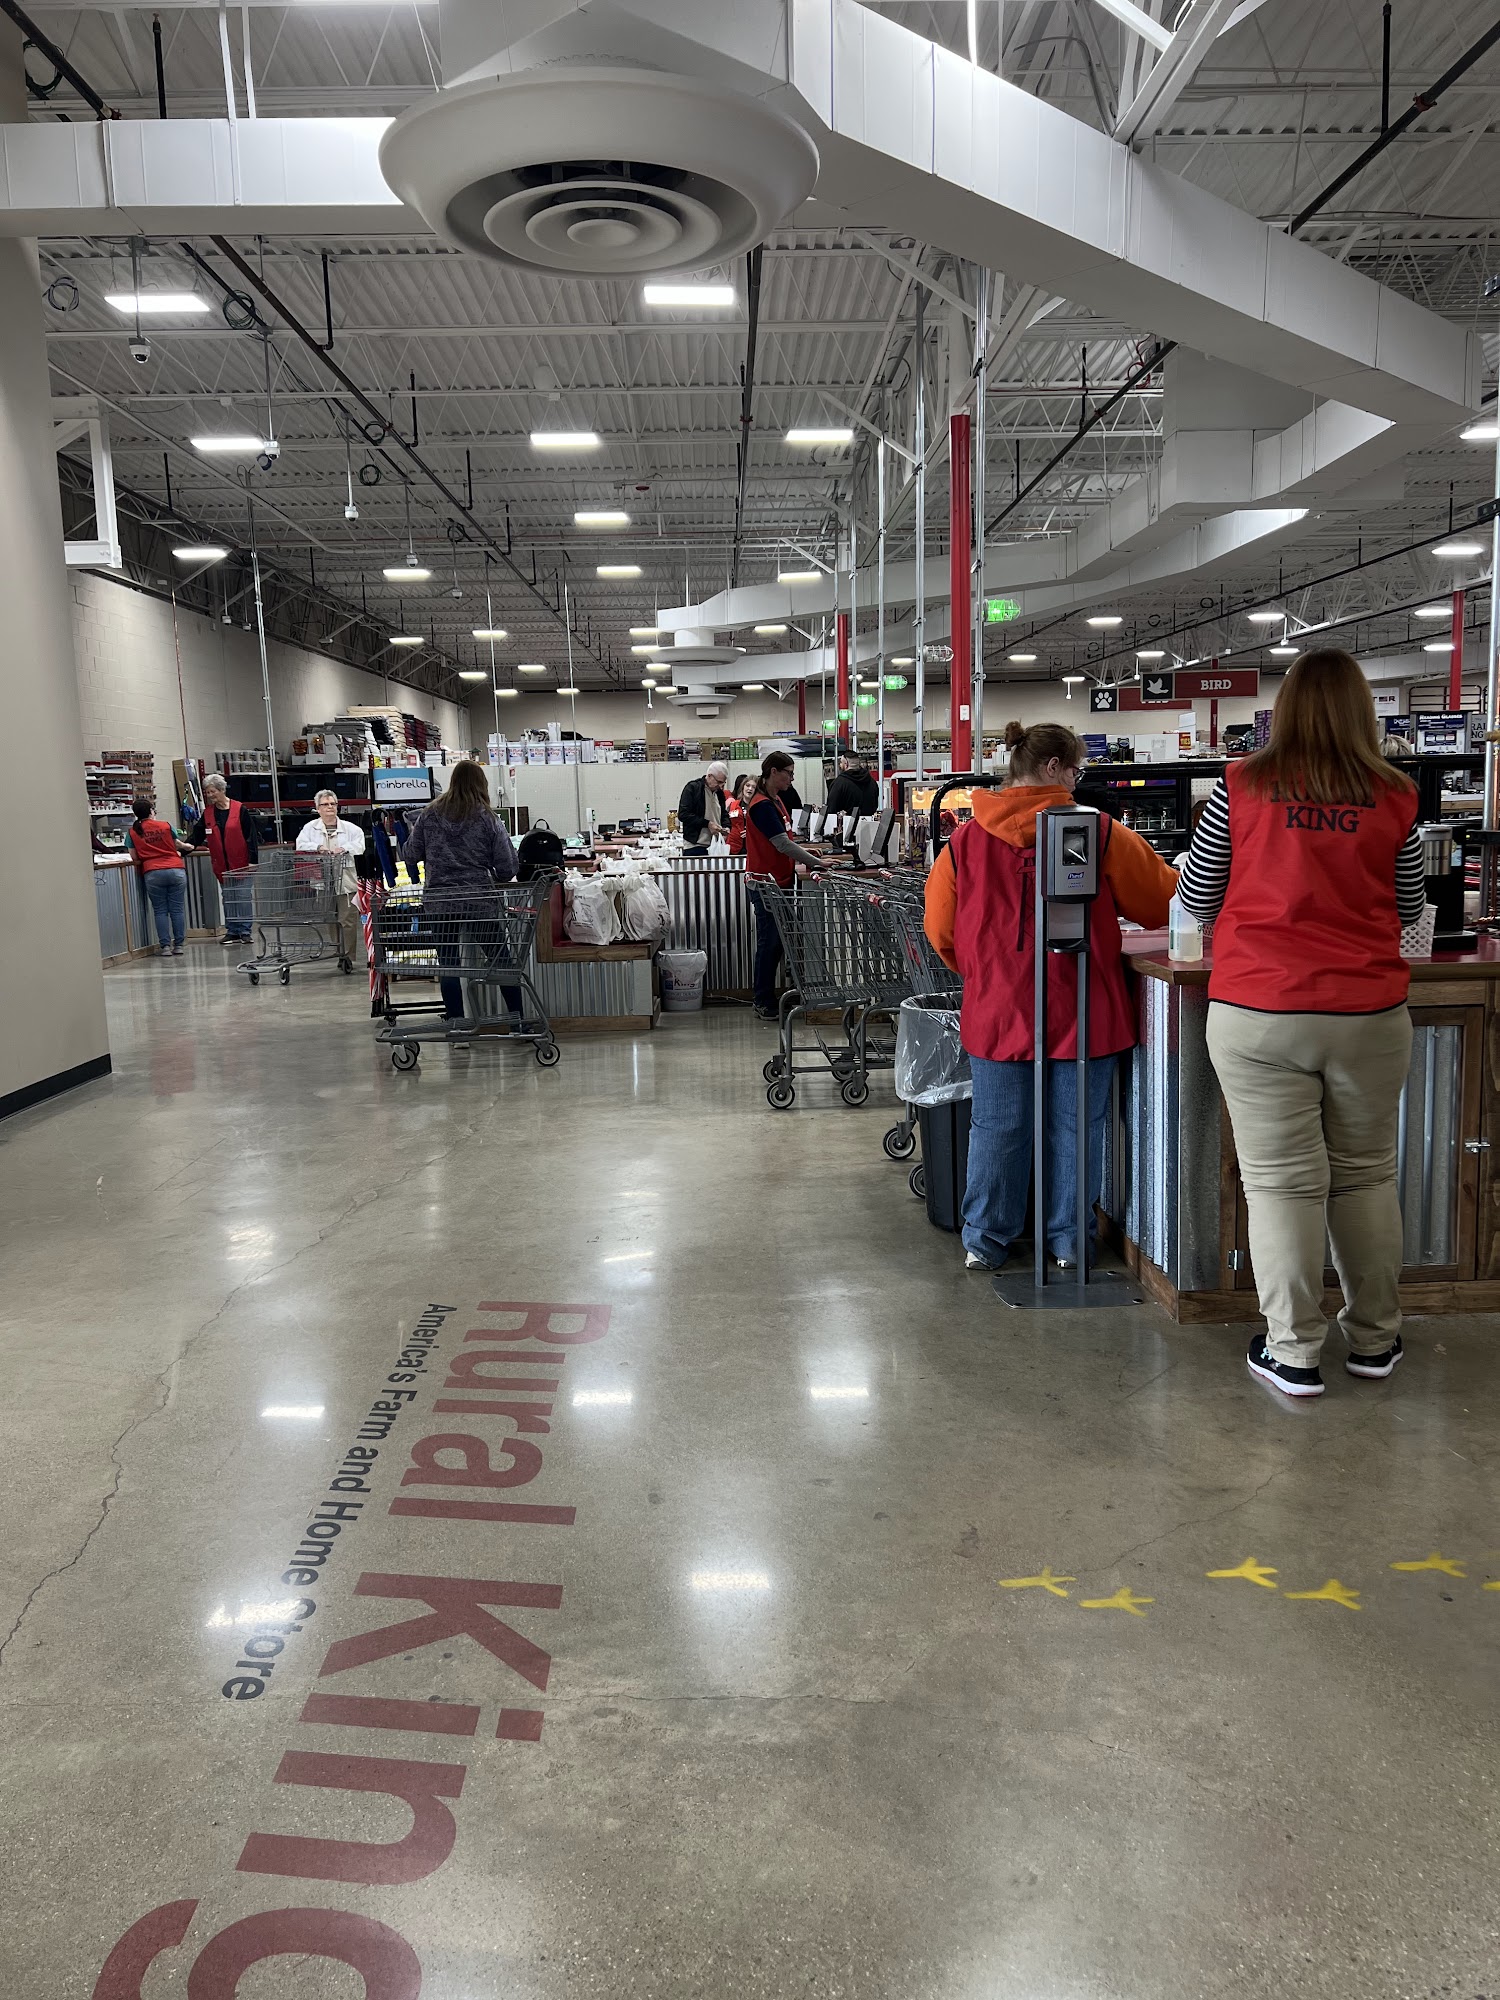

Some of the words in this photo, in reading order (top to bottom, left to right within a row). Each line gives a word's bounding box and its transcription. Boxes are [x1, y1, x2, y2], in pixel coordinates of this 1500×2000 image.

[1200, 679, 1232, 691] BIRD
[1285, 806, 1360, 833] KING
[388, 1302, 458, 1384] America's
[356, 1388, 418, 1440] Farm
[388, 1300, 612, 1524] Rural
[328, 1446, 379, 1493] and
[280, 1501, 364, 1586] Home
